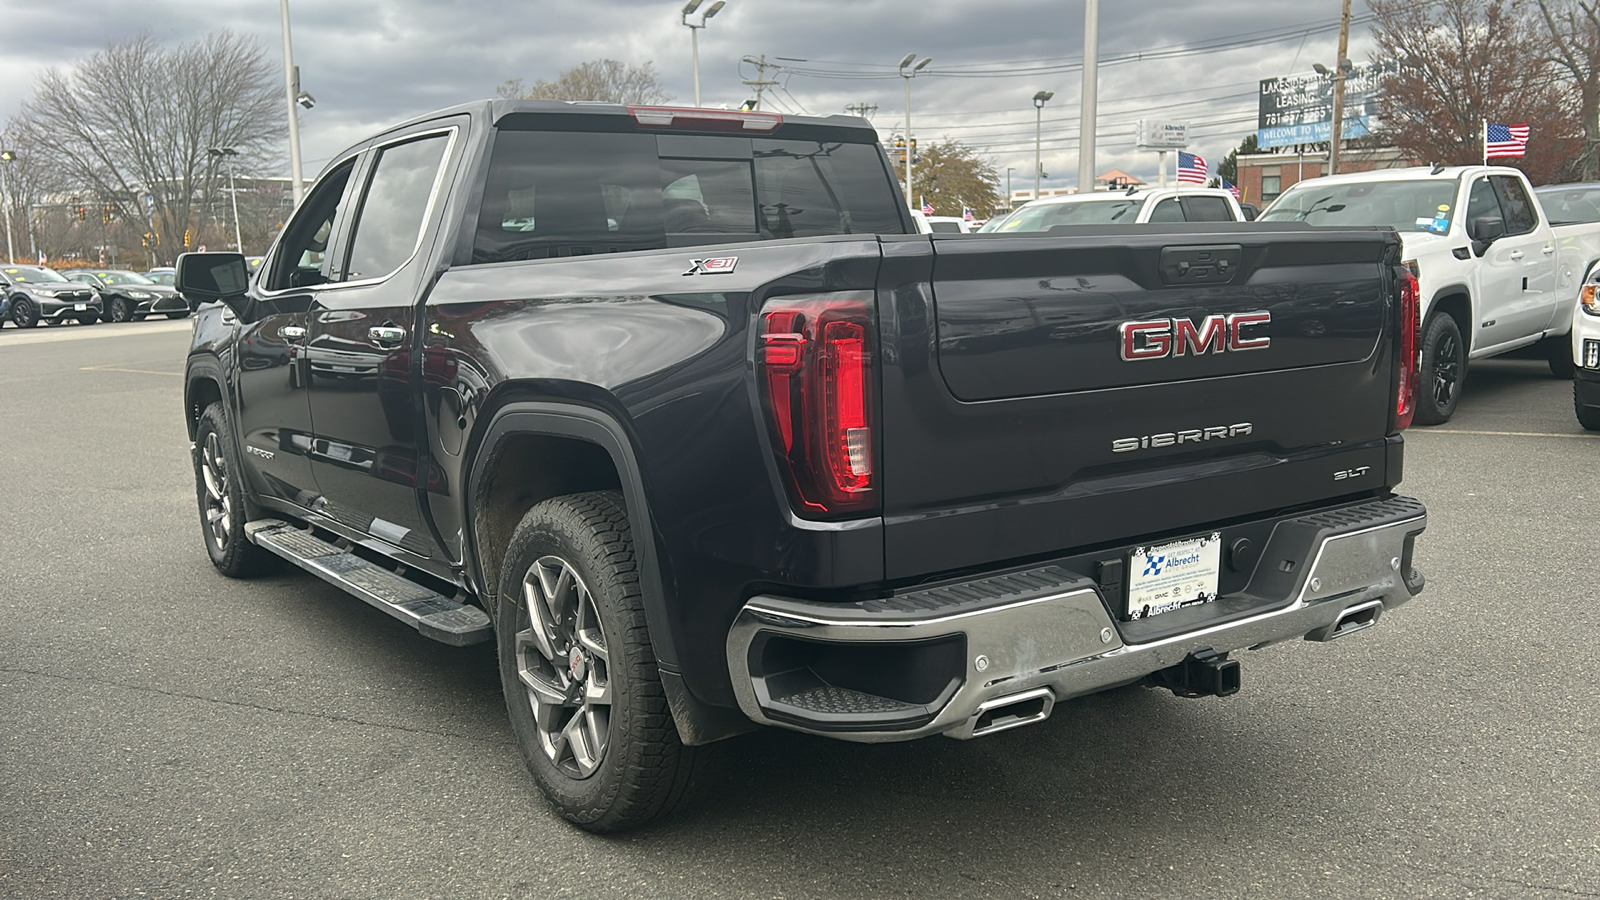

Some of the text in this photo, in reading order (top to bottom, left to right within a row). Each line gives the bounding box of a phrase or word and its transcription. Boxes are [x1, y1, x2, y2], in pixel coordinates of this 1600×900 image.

[1262, 77, 1306, 95] LAKESIDE
[1276, 92, 1315, 108] LEASING
[1263, 126, 1297, 139] WELCOME
[1301, 125, 1311, 135] TO
[682, 256, 739, 276] X31
[1120, 310, 1271, 362] GMC
[1112, 422, 1253, 453] SIERRA
[1333, 466, 1370, 481] SLT
[1165, 553, 1200, 569] Albrecht
[1154, 592, 1169, 600] GMC
[1147, 601, 1181, 618] Albrecht
